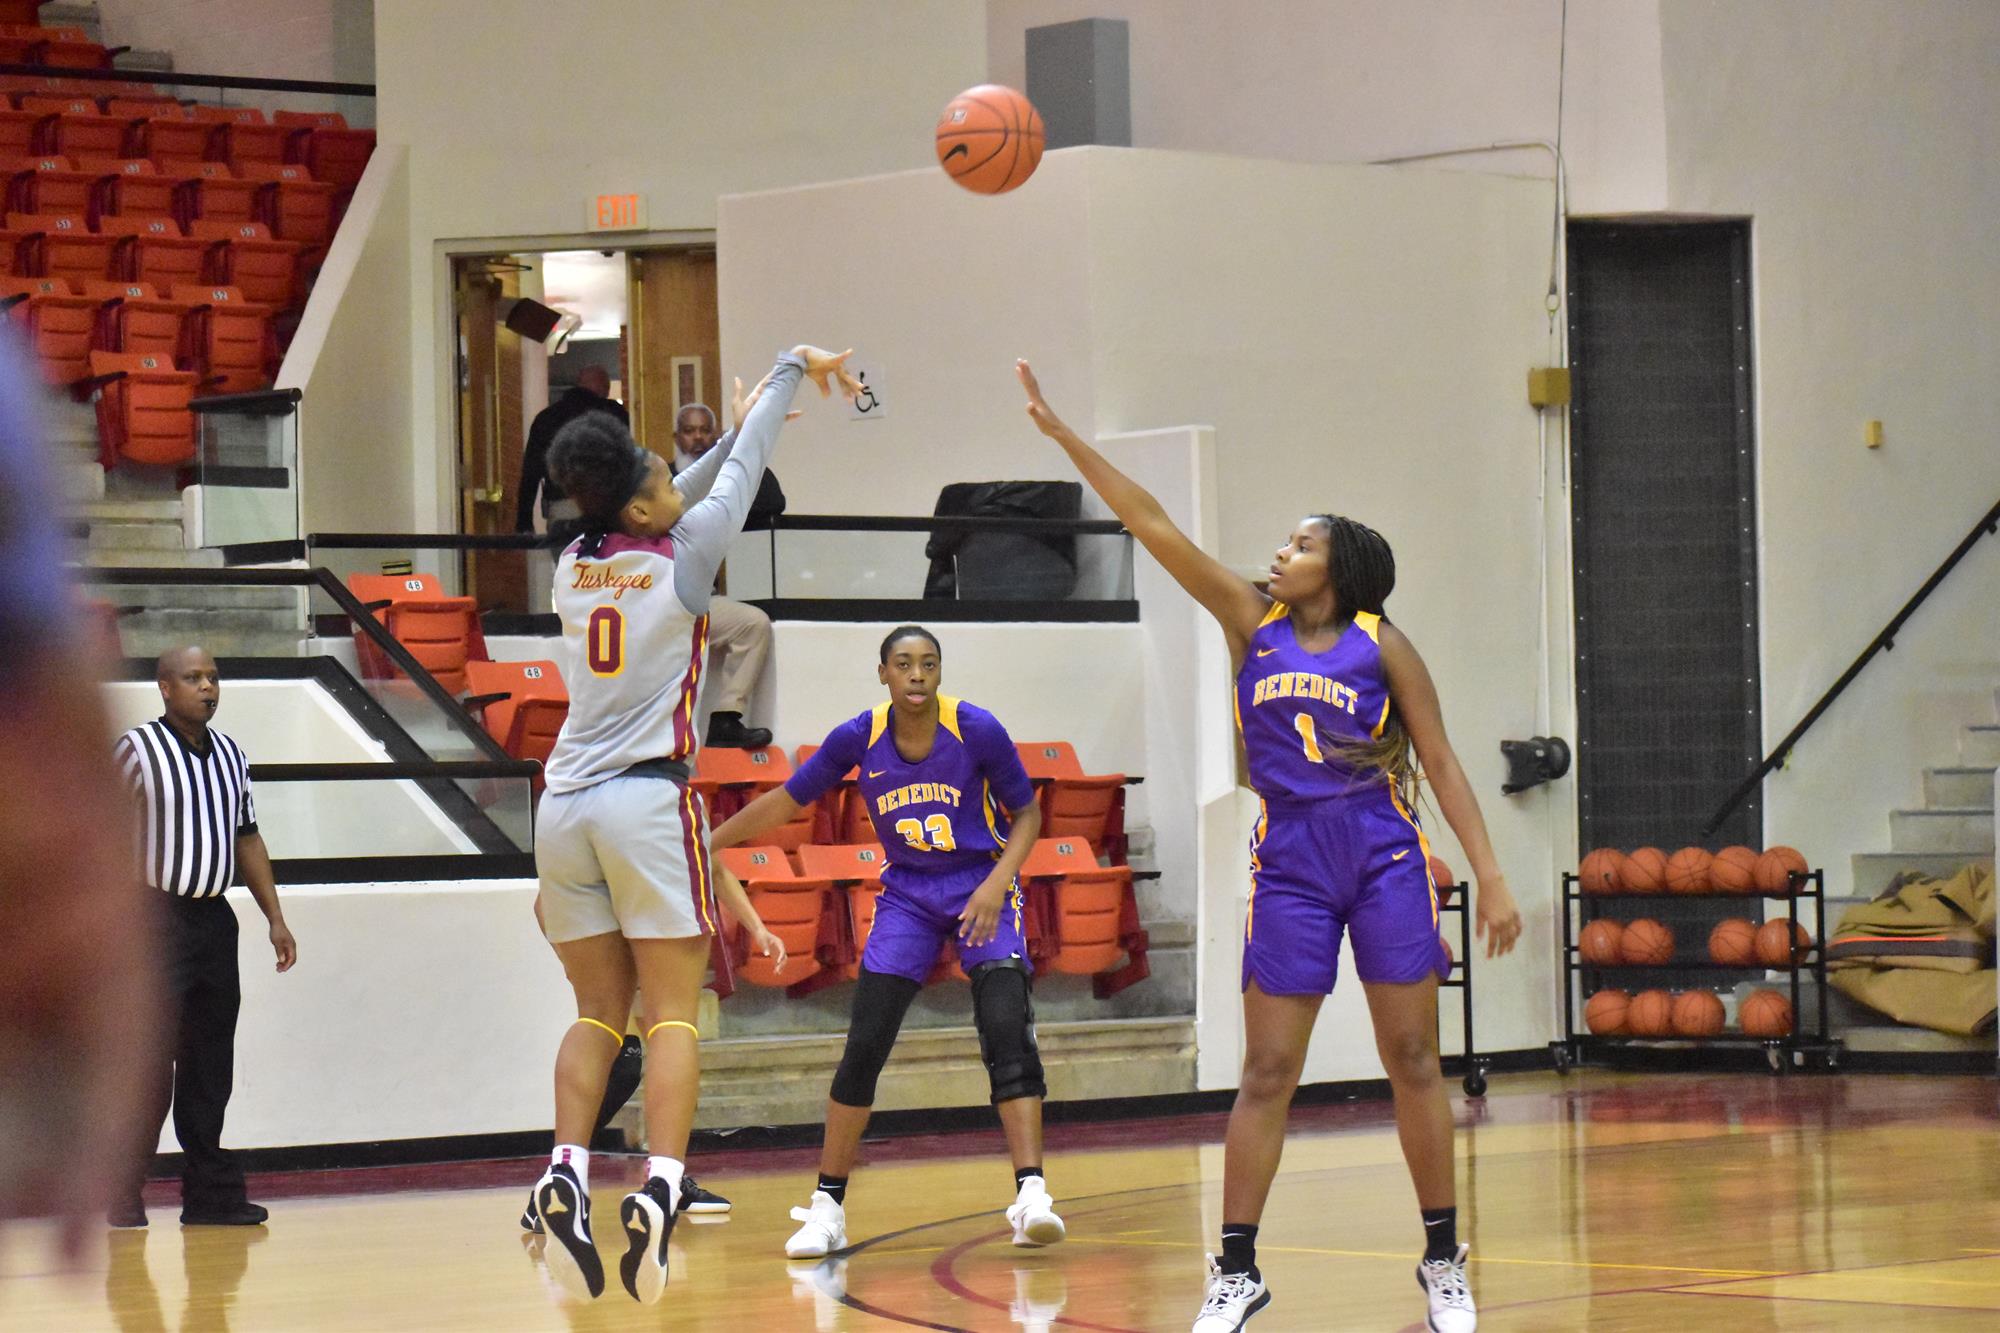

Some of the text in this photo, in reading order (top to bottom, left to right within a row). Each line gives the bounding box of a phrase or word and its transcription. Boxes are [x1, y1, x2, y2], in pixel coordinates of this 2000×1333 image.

[597, 193, 639, 226] EXIT
[128, 287, 140, 297] 51
[213, 290, 226, 300] 52
[407, 580, 421, 590] 48
[572, 562, 653, 600] Tuskegee
[586, 605, 625, 677] 0
[527, 667, 541, 678] 48
[1252, 671, 1358, 715] BENEDICT
[1294, 712, 1323, 763] 1
[753, 752, 767, 763] 40
[876, 782, 962, 815] BENEDICT
[895, 813, 957, 852] 33
[1058, 843, 1073, 855] 42
[752, 853, 767, 865] 39
[859, 850, 874, 862] 40
